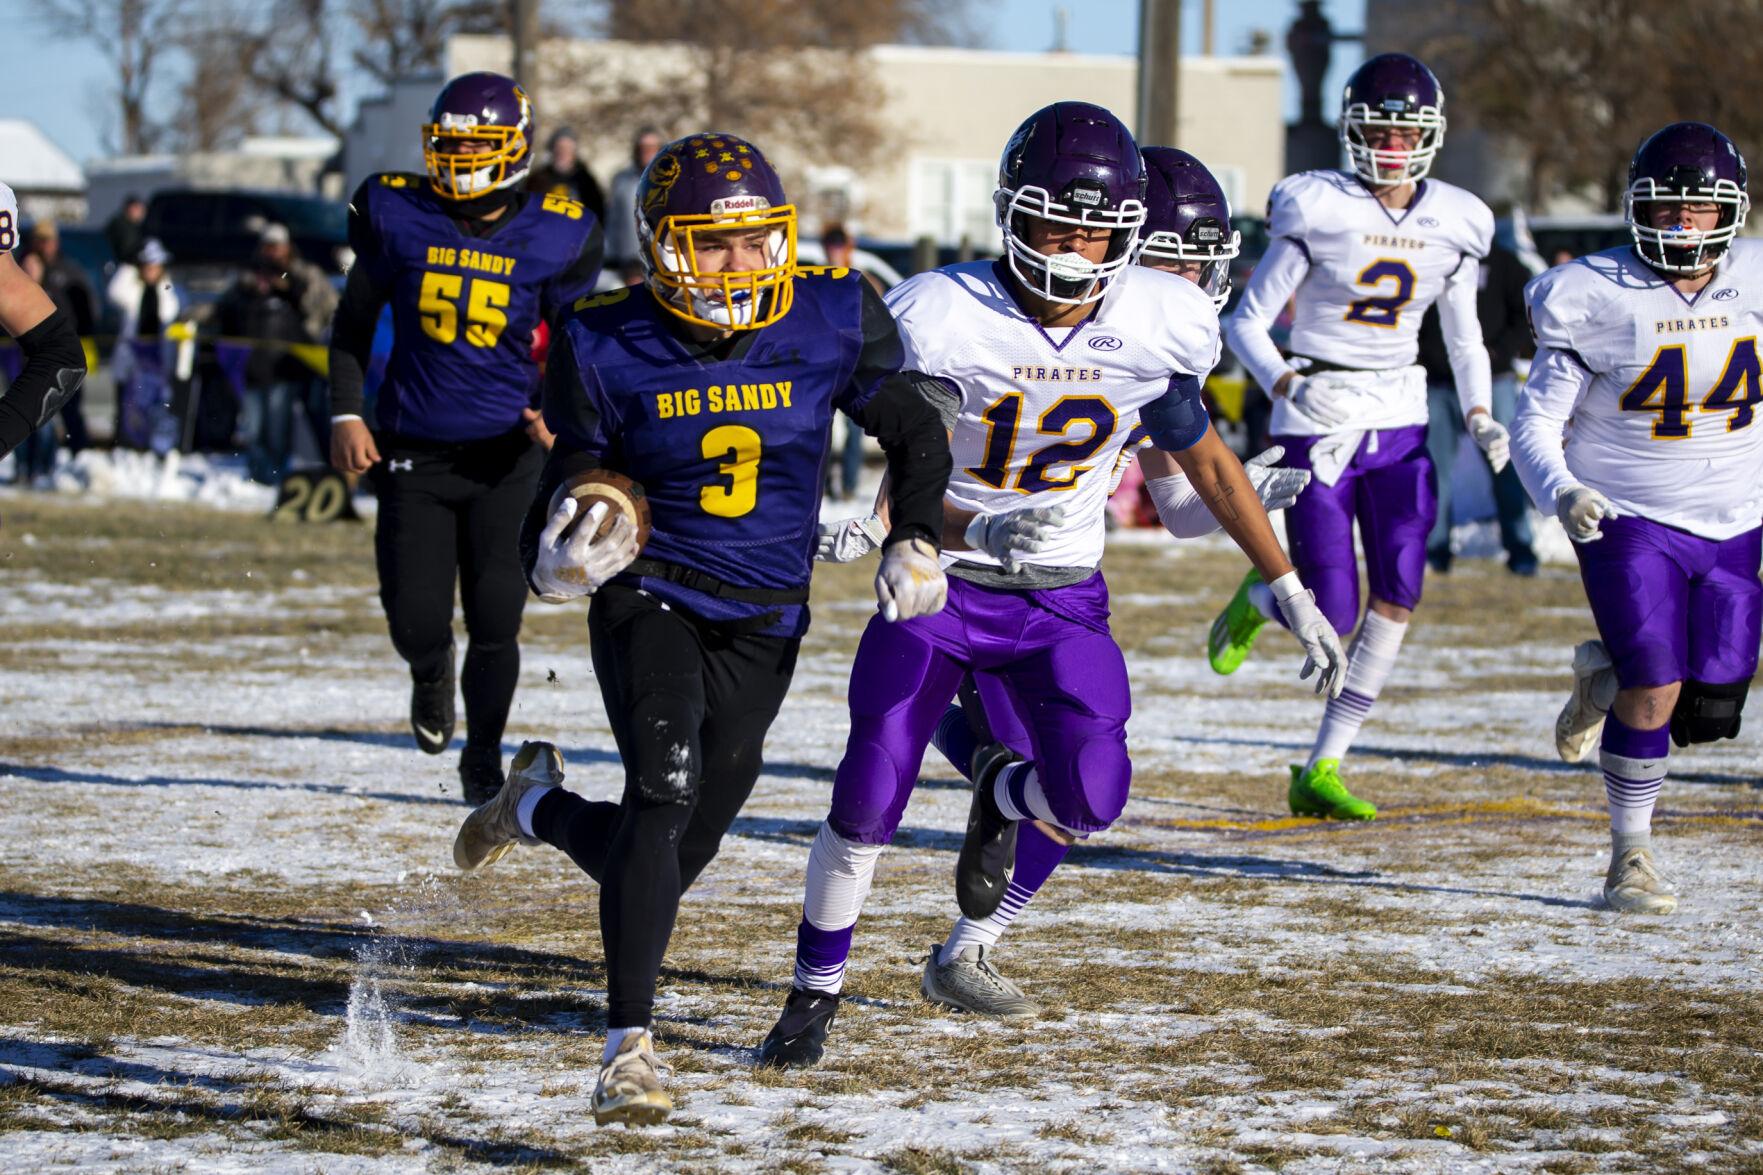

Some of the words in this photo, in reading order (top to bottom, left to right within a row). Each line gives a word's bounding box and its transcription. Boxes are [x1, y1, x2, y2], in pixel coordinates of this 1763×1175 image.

[1074, 191, 1101, 202] schutt
[426, 245, 457, 267] BIG
[458, 248, 517, 276] SANDY
[1363, 233, 1425, 249] PIRATES
[418, 270, 511, 349] 55
[1343, 256, 1418, 330] 2
[1655, 315, 1731, 335] PIRATES
[1012, 366, 1103, 382] PIRATES
[1618, 334, 1763, 440] 44
[656, 389, 701, 419] BIG
[707, 381, 792, 413] SANDY
[963, 391, 1119, 496] 12
[700, 424, 762, 518] 3
[276, 475, 345, 522] 20
